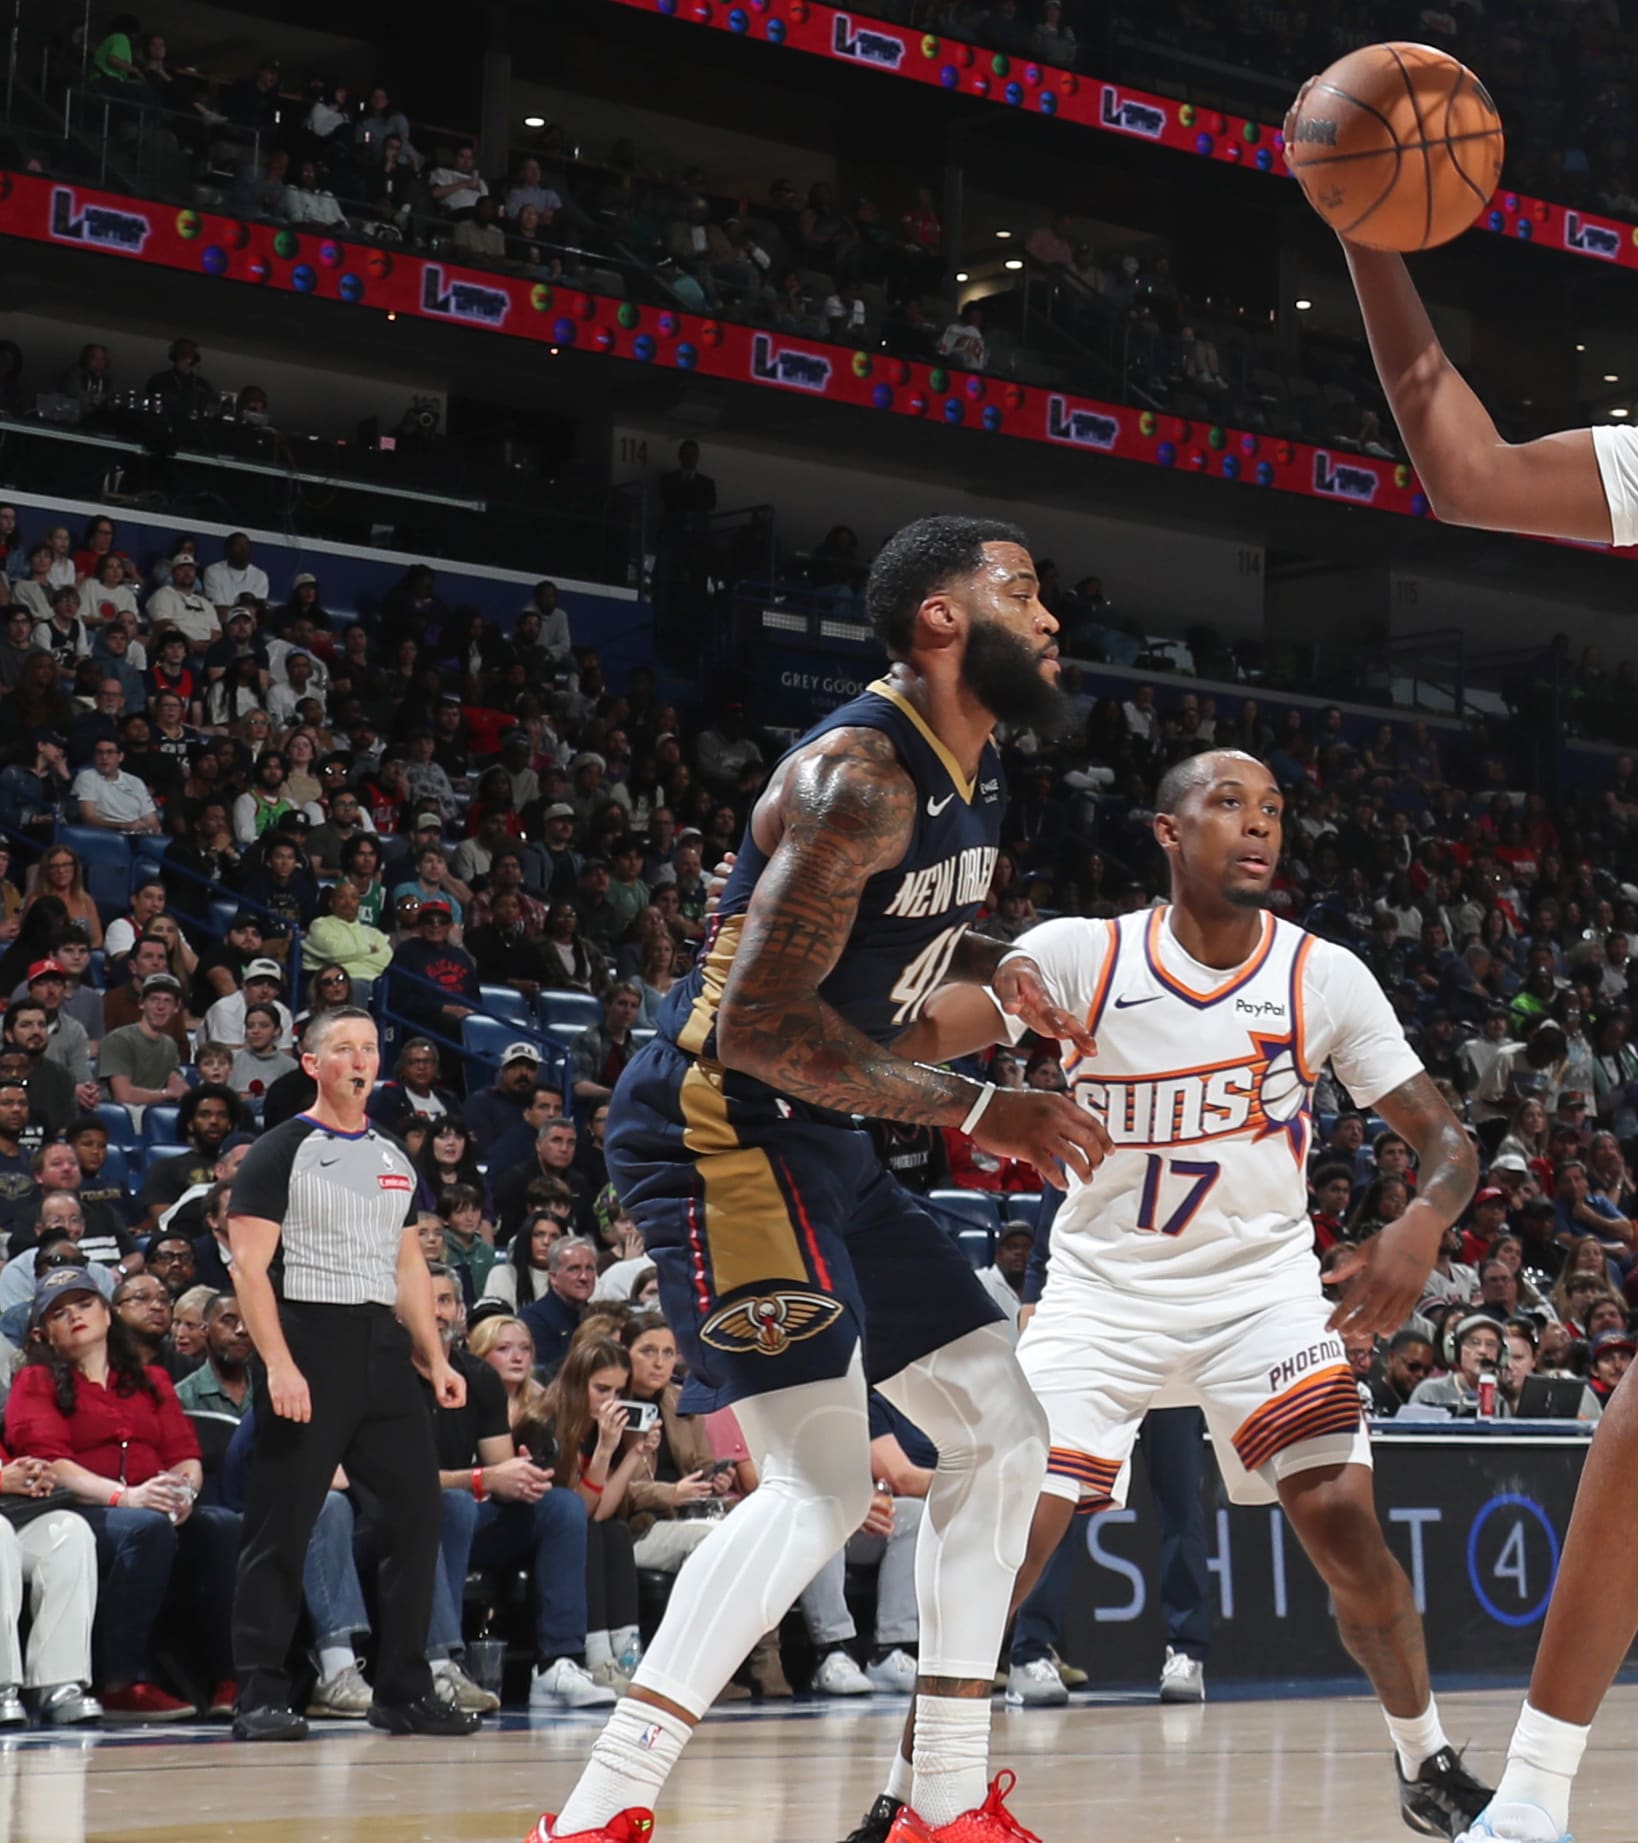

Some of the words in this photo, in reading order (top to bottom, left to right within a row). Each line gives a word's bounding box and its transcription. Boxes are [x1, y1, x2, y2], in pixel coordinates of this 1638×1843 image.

[780, 671, 819, 690] GREY
[822, 677, 865, 696] GOOS
[883, 856, 956, 918] NEW
[956, 846, 999, 907] ORLE
[1236, 998, 1285, 1018] PayPal
[1137, 1152, 1221, 1237] 17
[1086, 1508, 1441, 1622] SHIT
[1493, 1520, 1528, 1599] 4
